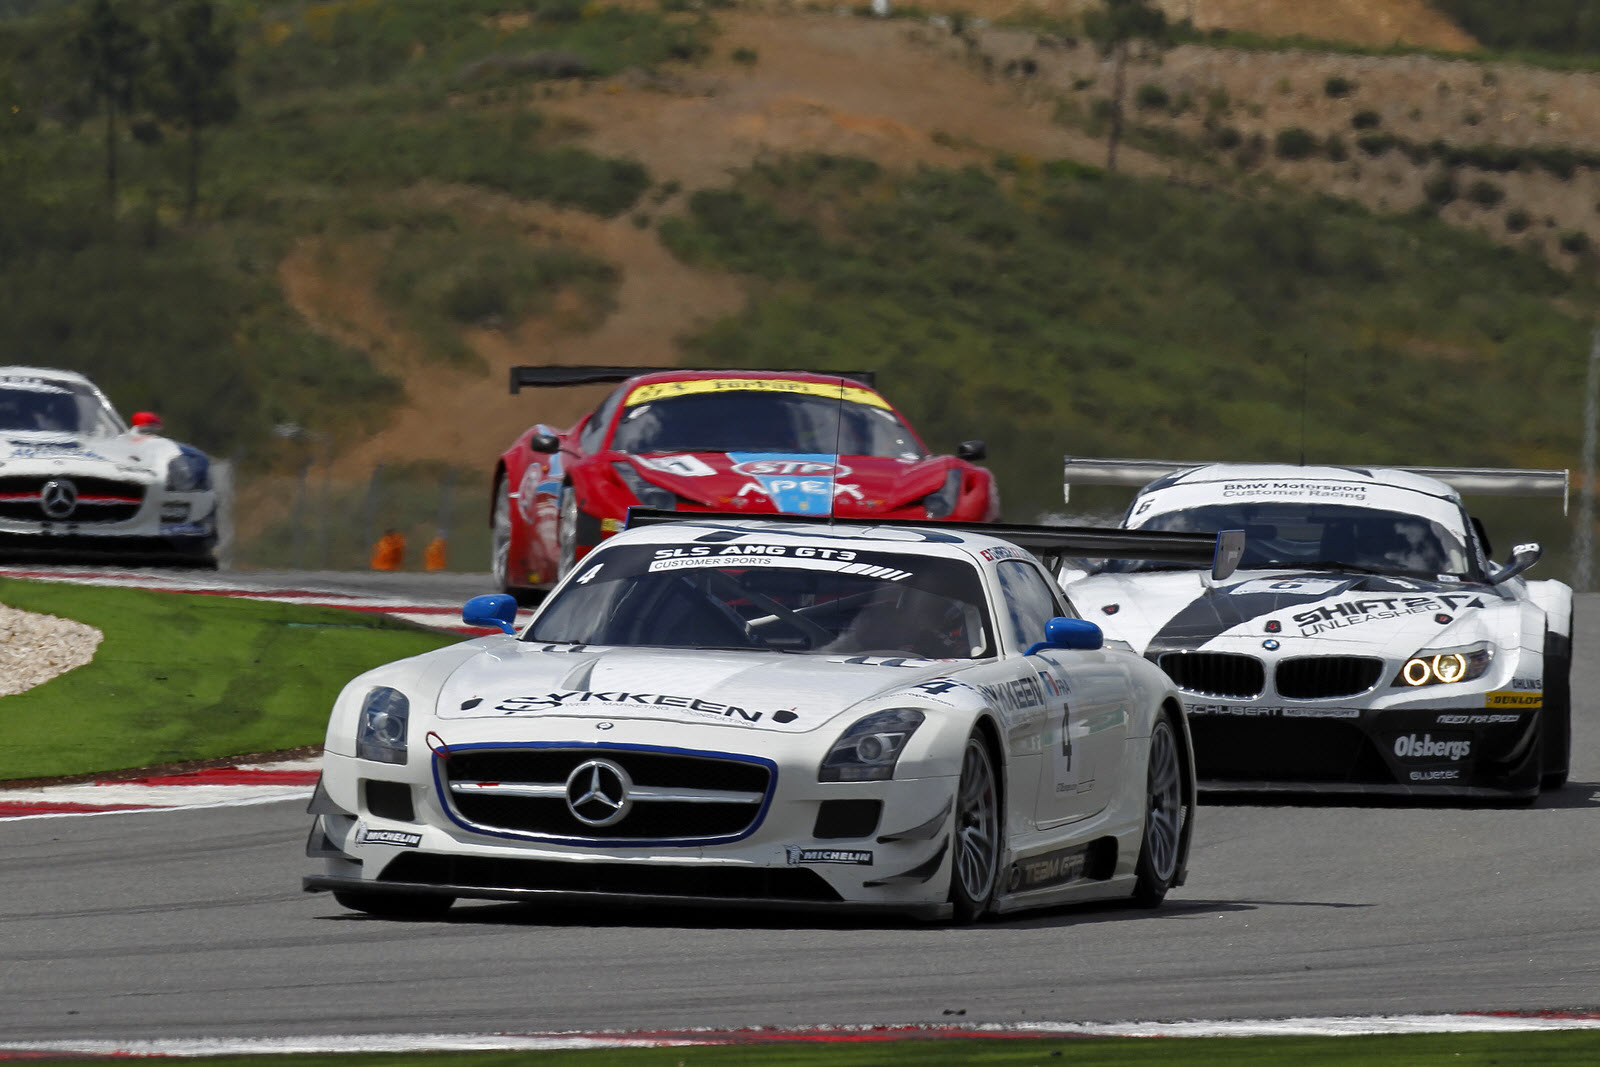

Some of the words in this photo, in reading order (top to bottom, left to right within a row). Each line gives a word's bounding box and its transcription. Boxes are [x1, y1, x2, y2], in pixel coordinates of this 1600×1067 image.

[751, 461, 836, 475] STP
[737, 480, 864, 500] APEX
[1222, 489, 1303, 498] Customer
[1309, 489, 1367, 500] Racing
[1223, 482, 1267, 491] BMW
[1273, 482, 1367, 493] Motorsport
[653, 546, 711, 560] SLS
[719, 545, 787, 557] AMG
[794, 546, 858, 561] GT3
[654, 558, 720, 570] CUSTOMER
[723, 557, 772, 566] SPORTS
[576, 563, 605, 584] 4
[1292, 598, 1399, 627] SHIFT
[1400, 597, 1437, 608] 2
[1300, 602, 1442, 638] UNLEASHED
[911, 681, 959, 695] 4
[495, 691, 763, 722] SYKKEEN
[1493, 695, 1542, 705] DUNLOP
[601, 701, 669, 711] MARKETING
[680, 708, 756, 727] CONSULTING
[1185, 704, 1283, 716] SCHUBERT
[1436, 714, 1467, 724] NEED
[1468, 714, 1488, 724] FOR
[1487, 713, 1521, 723] SPEED
[1061, 702, 1073, 773] 4
[1394, 733, 1471, 761] Olsbergs
[366, 831, 421, 844] MICHELIN
[803, 851, 871, 861] MICHELIN
